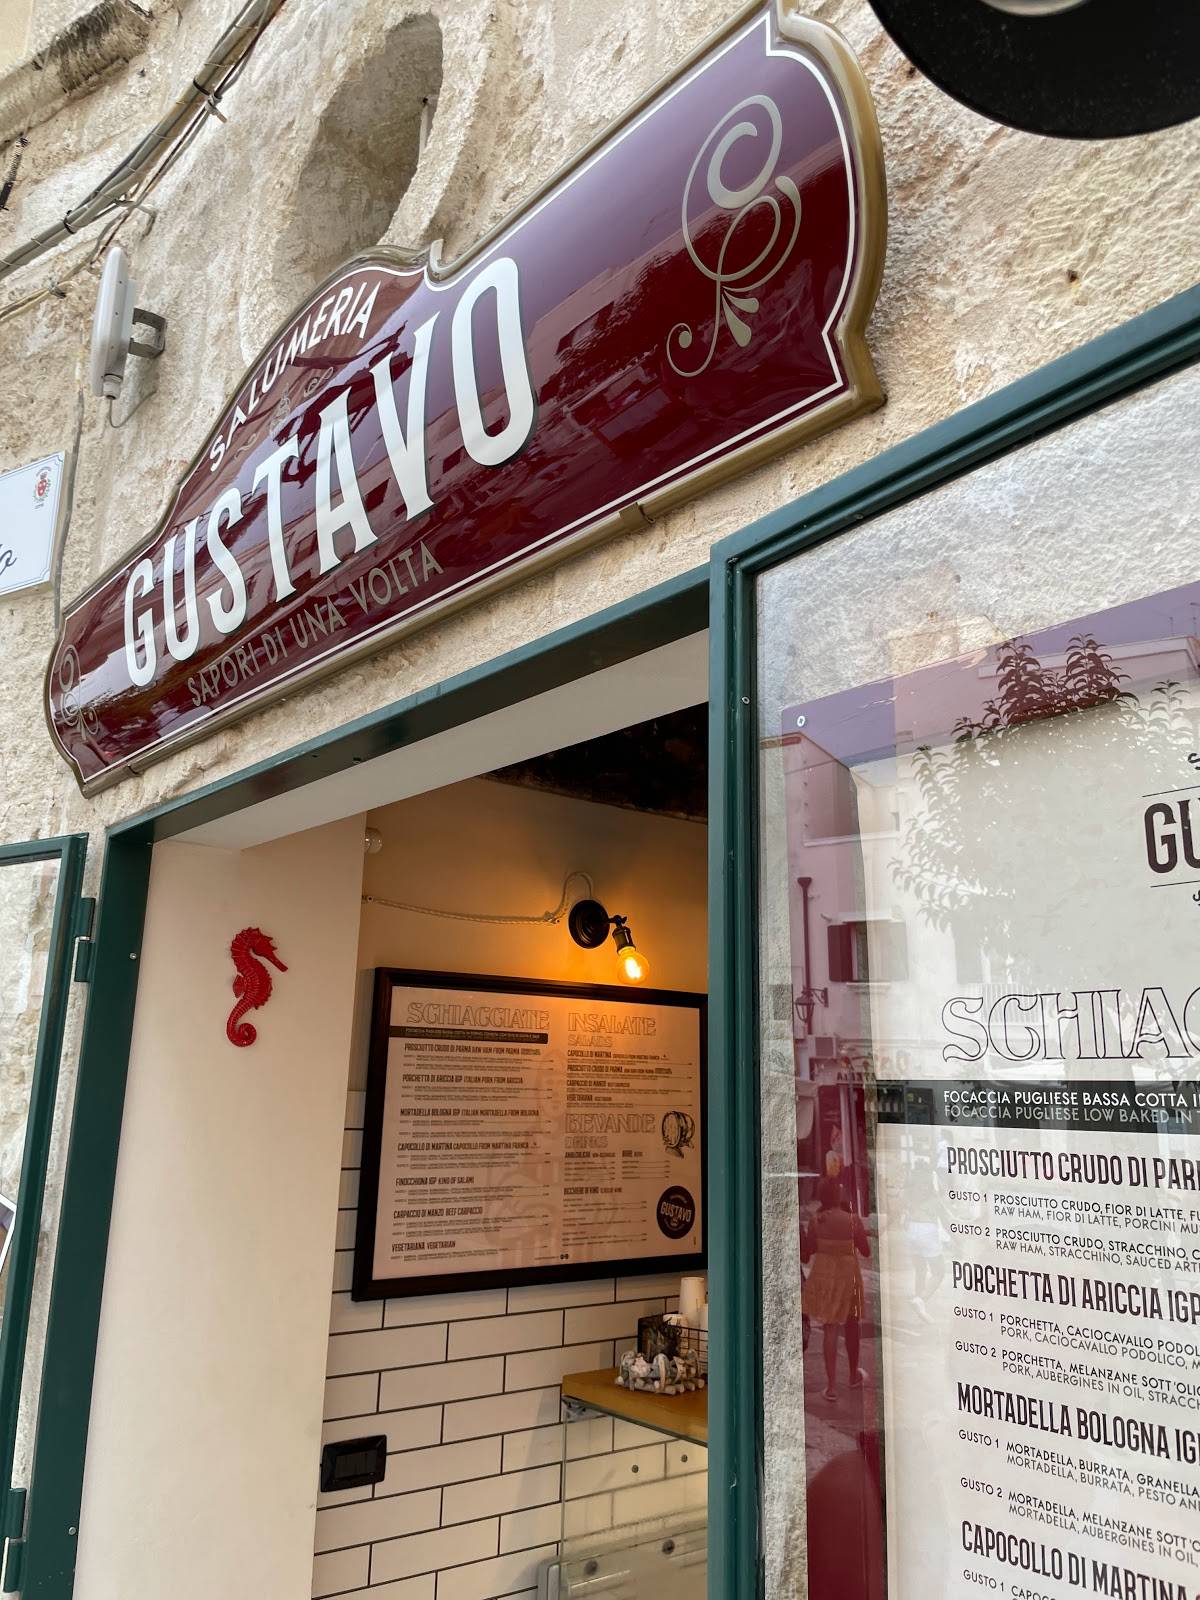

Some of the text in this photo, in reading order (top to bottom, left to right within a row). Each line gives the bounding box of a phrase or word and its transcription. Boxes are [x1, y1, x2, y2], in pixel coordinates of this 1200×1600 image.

[209, 280, 381, 473] SALUMERIA
[123, 256, 536, 688] GUSTAVO
[187, 540, 445, 707] SAPORI DI UNA VOLTA
[943, 1090, 1010, 1104] FOCACCIA
[1014, 1091, 1079, 1106] PUGLIESE
[1082, 1092, 1130, 1106] BASSA
[1134, 1092, 1188, 1107] COTTA
[944, 1105, 1193, 1124] FOCACCIA PUGLIESE LOW BAKED IN
[947, 1147, 1054, 1180] PROSCIUTTO
[1058, 1152, 1123, 1185] CRUDO
[1127, 1156, 1148, 1187] DI
[660, 1201, 692, 1223] GUSTAVO
[948, 1190, 980, 1202] GUSTO
[983, 1193, 987, 1203] 1
[994, 1194, 1058, 1209] PROSCIUTTO
[1061, 1200, 1103, 1214] CRUDO,
[1105, 1203, 1132, 1216] FIOR
[1135, 1205, 1147, 1217] DI
[1149, 1206, 1186, 1222] LATTE,
[994, 1206, 1015, 1217] RAW
[1018, 1208, 1044, 1221] HAM,
[1046, 1210, 1072, 1223] FIOR
[1074, 1213, 1085, 1224] DI
[1088, 1214, 1122, 1228] LATTE,
[1125, 1217, 1176, 1233] PORCINI
[950, 1223, 982, 1236] GUSTO
[985, 1227, 990, 1237] 2
[995, 1228, 1060, 1245] PROSCIUTTO
[1064, 1235, 1105, 1251] CRUDO,
[1108, 1240, 1188, 1260] STRACCHINO,
[996, 1240, 1017, 1251] RAW
[1020, 1242, 1046, 1256] HAM,
[1048, 1246, 1123, 1266] STRACCHINO,
[1126, 1254, 1172, 1270] SAUCED
[952, 1260, 1200, 1325] PORCHETTA DI ARICCIA IGP
[953, 1306, 986, 1321] GUSTO
[989, 1312, 993, 1322] 1
[1000, 1313, 1064, 1336] PORCHETTA,
[1066, 1325, 1154, 1349] CACIOCAVALLO
[1000, 1326, 1032, 1342] PORK,
[1034, 1332, 1118, 1355] CACIOCAVALLO
[1121, 1346, 1187, 1370] PODOLICO,
[955, 1340, 988, 1356] GUSTO
[990, 1347, 997, 1358] 2
[1001, 1349, 1066, 1372] PORCHETTA,
[1069, 1363, 1138, 1385] MELANZANE
[1002, 1361, 1034, 1379] PORK,
[1036, 1369, 1104, 1392] AUBERGINES
[1107, 1382, 1120, 1394] IN
[1123, 1385, 1145, 1401] OIL,
[957, 1381, 1200, 1466] MORTADELLA BOLOGNA IG
[958, 1429, 1200, 1498] GUSTO 1 MORTADELLA, BURRATA, GRANELLA
[1006, 1454, 1200, 1512] MORTADELLA, BURRATA, PESTO AN
[960, 1477, 994, 1495] GUSTO
[996, 1487, 1003, 1498] 2
[1008, 1491, 1079, 1521] MORTADELLA,
[1082, 1511, 1152, 1539] MELANZANE
[961, 1520, 1063, 1581] CAPOCOLLO
[1068, 1551, 1086, 1589] DI
[1009, 1504, 1198, 1567] MORTADELLA, AUBERGINES IN OIL,
[963, 1569, 997, 1589] GUSTO
[1000, 1581, 1004, 1592] 1
